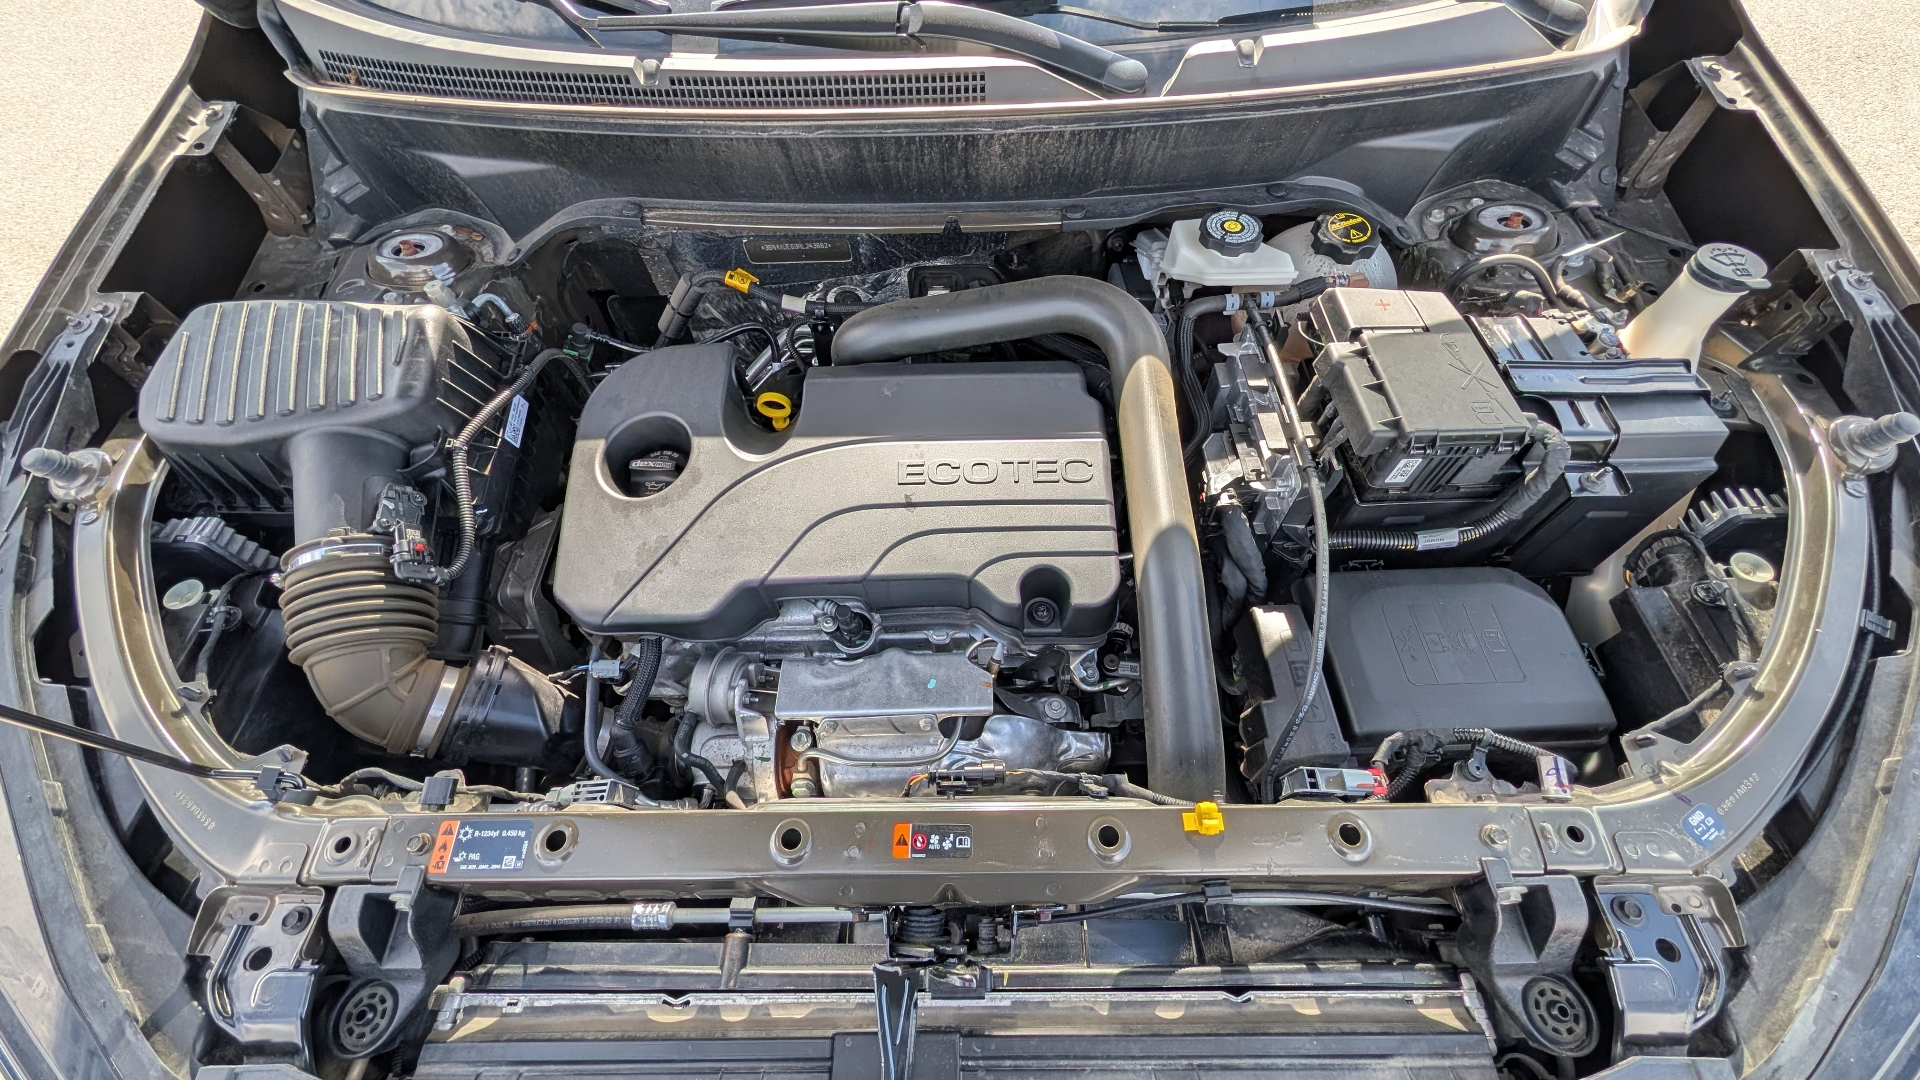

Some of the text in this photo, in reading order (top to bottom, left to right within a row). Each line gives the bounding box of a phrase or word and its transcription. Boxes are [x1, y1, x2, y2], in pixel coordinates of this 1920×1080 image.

[898, 458, 1094, 485] ECOTEC
[1688, 811, 1705, 826] GND
[474, 830, 500, 838] R-1234yf
[468, 853, 481, 861] PAG
